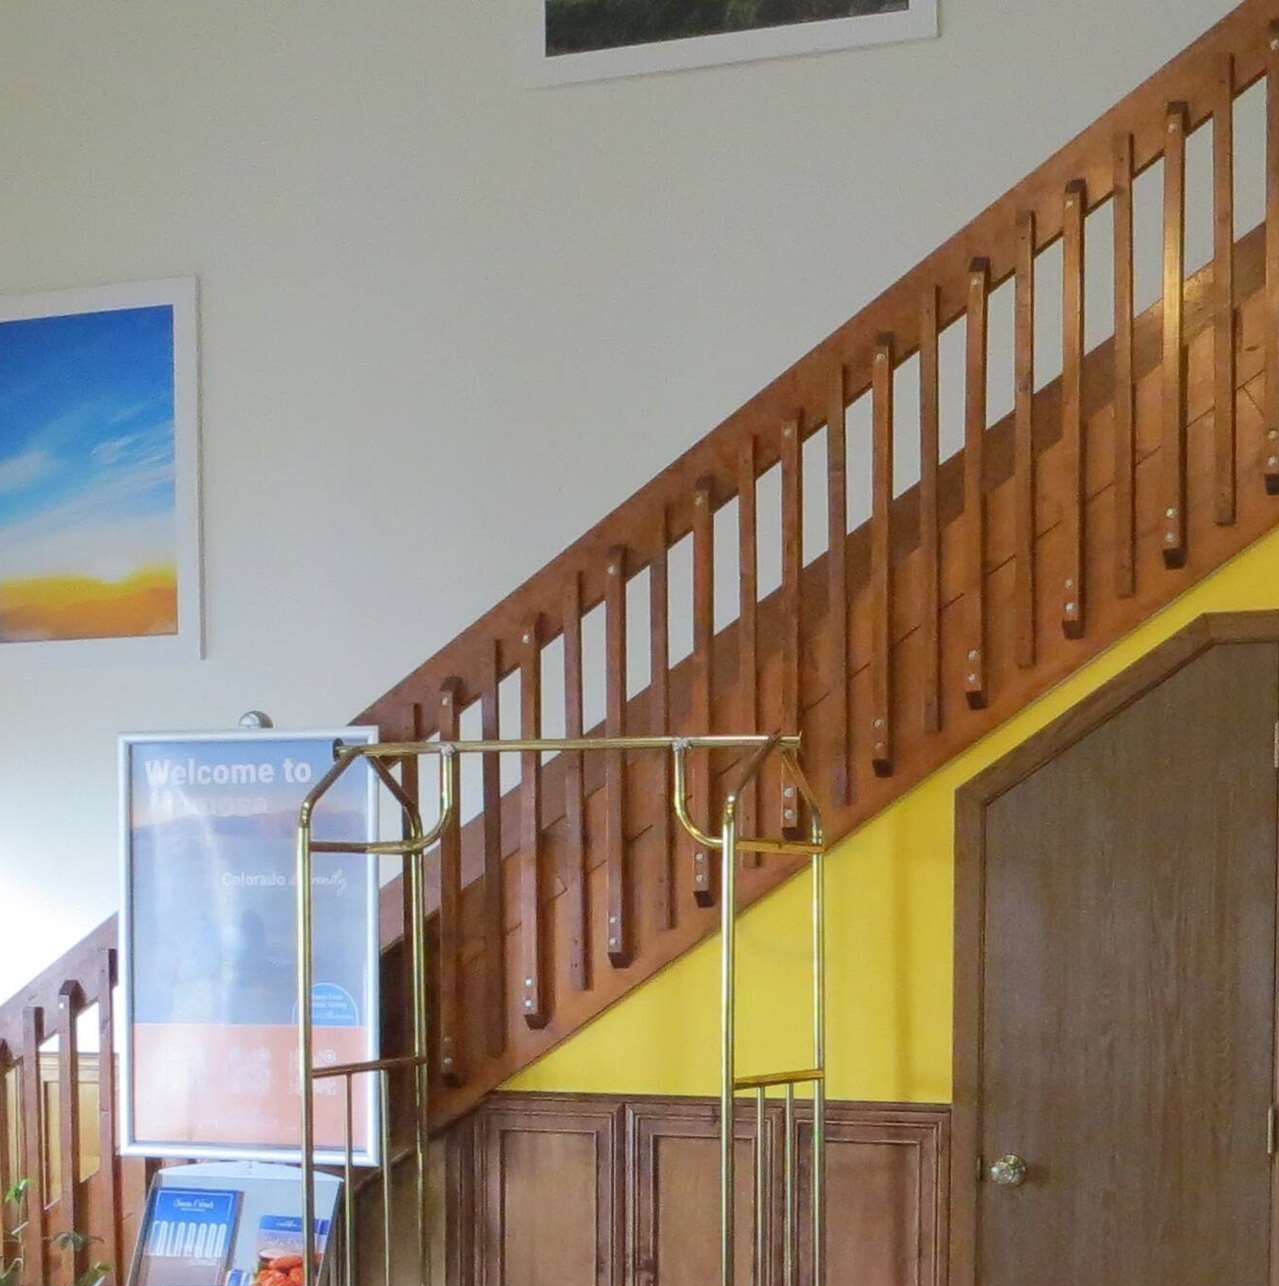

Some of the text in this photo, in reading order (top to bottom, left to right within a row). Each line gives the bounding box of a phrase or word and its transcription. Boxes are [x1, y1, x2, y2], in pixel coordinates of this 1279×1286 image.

[144, 757, 312, 785] Welcome to
[221, 870, 288, 889] Colorado
[150, 1220, 228, 1259] COLORADO
